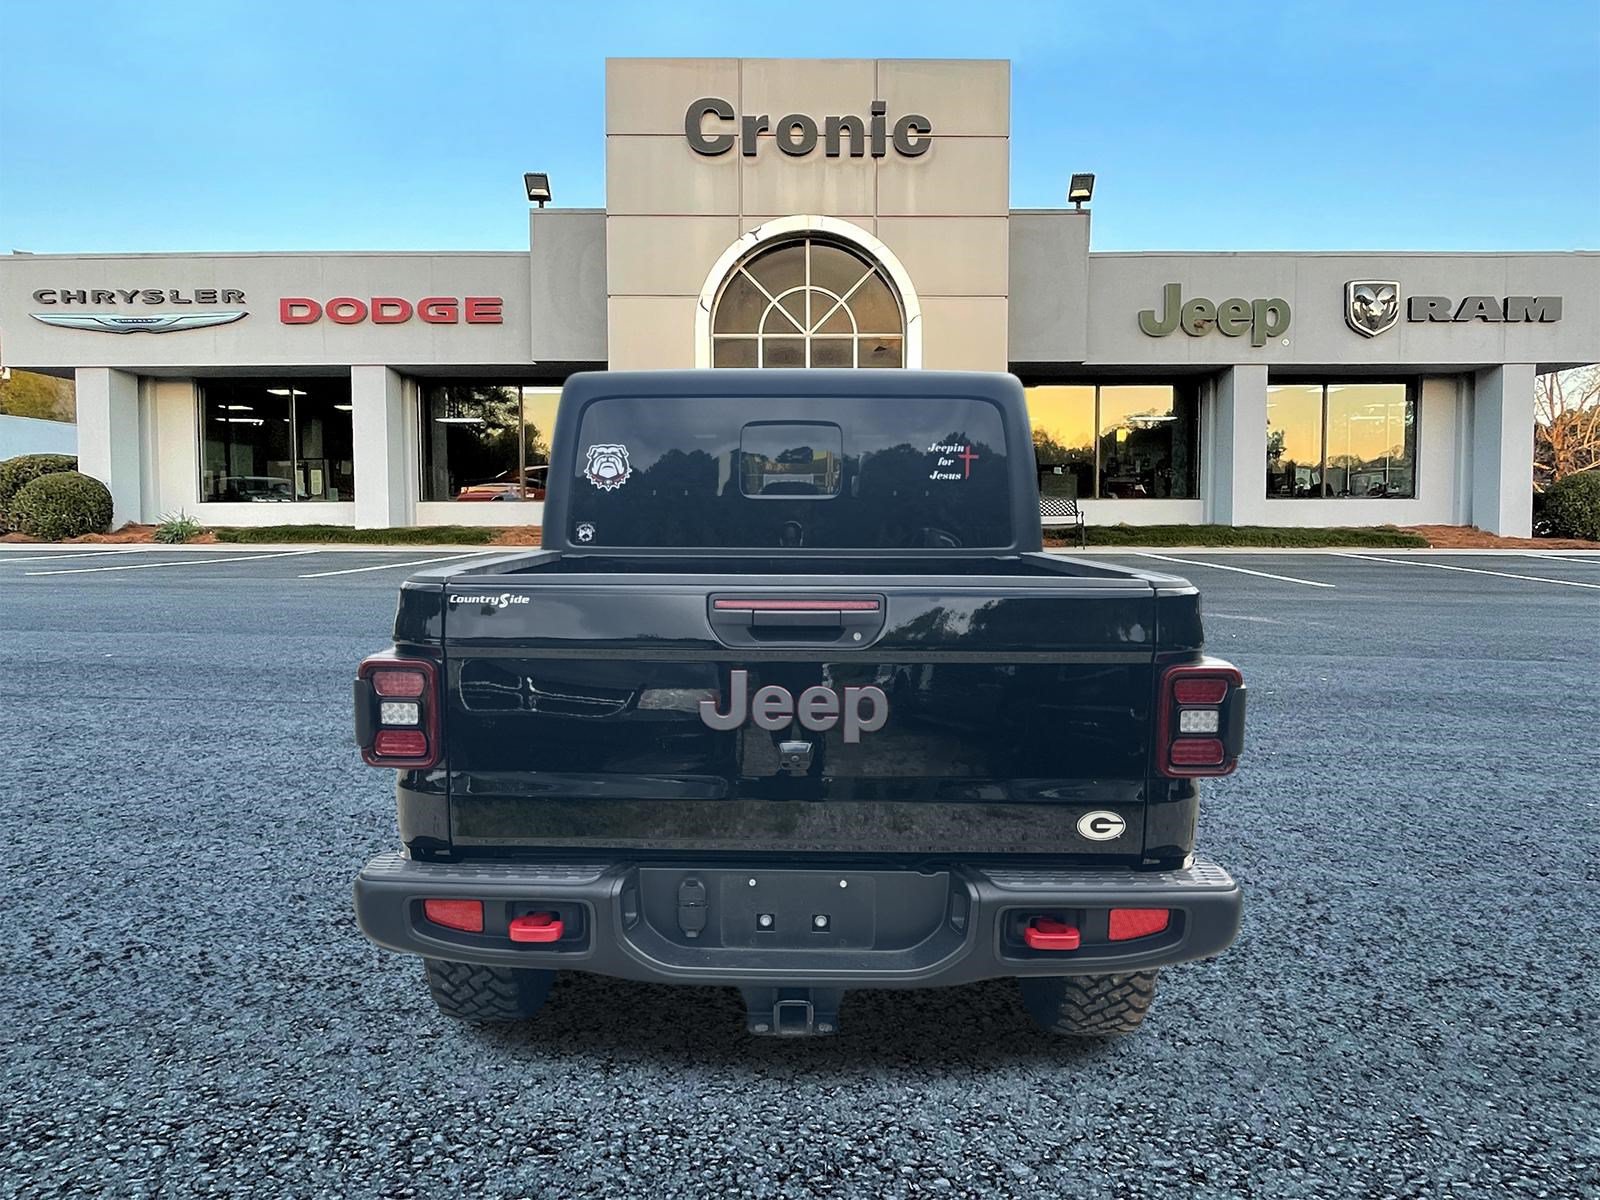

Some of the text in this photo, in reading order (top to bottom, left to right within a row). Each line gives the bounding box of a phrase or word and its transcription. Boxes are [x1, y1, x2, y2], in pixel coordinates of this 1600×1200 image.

[684, 97, 932, 157] Cronic
[32, 289, 246, 305] CHRYSLER
[280, 297, 503, 324] DODGE
[1407, 296, 1562, 323] RAM
[1138, 283, 1291, 347] Jeep
[928, 443, 964, 454] Jeepin
[937, 456, 954, 466] for
[929, 470, 961, 480] Jesus
[449, 593, 530, 608] CountrySide
[700, 669, 889, 743] Jeep
[1077, 810, 1126, 840] G
